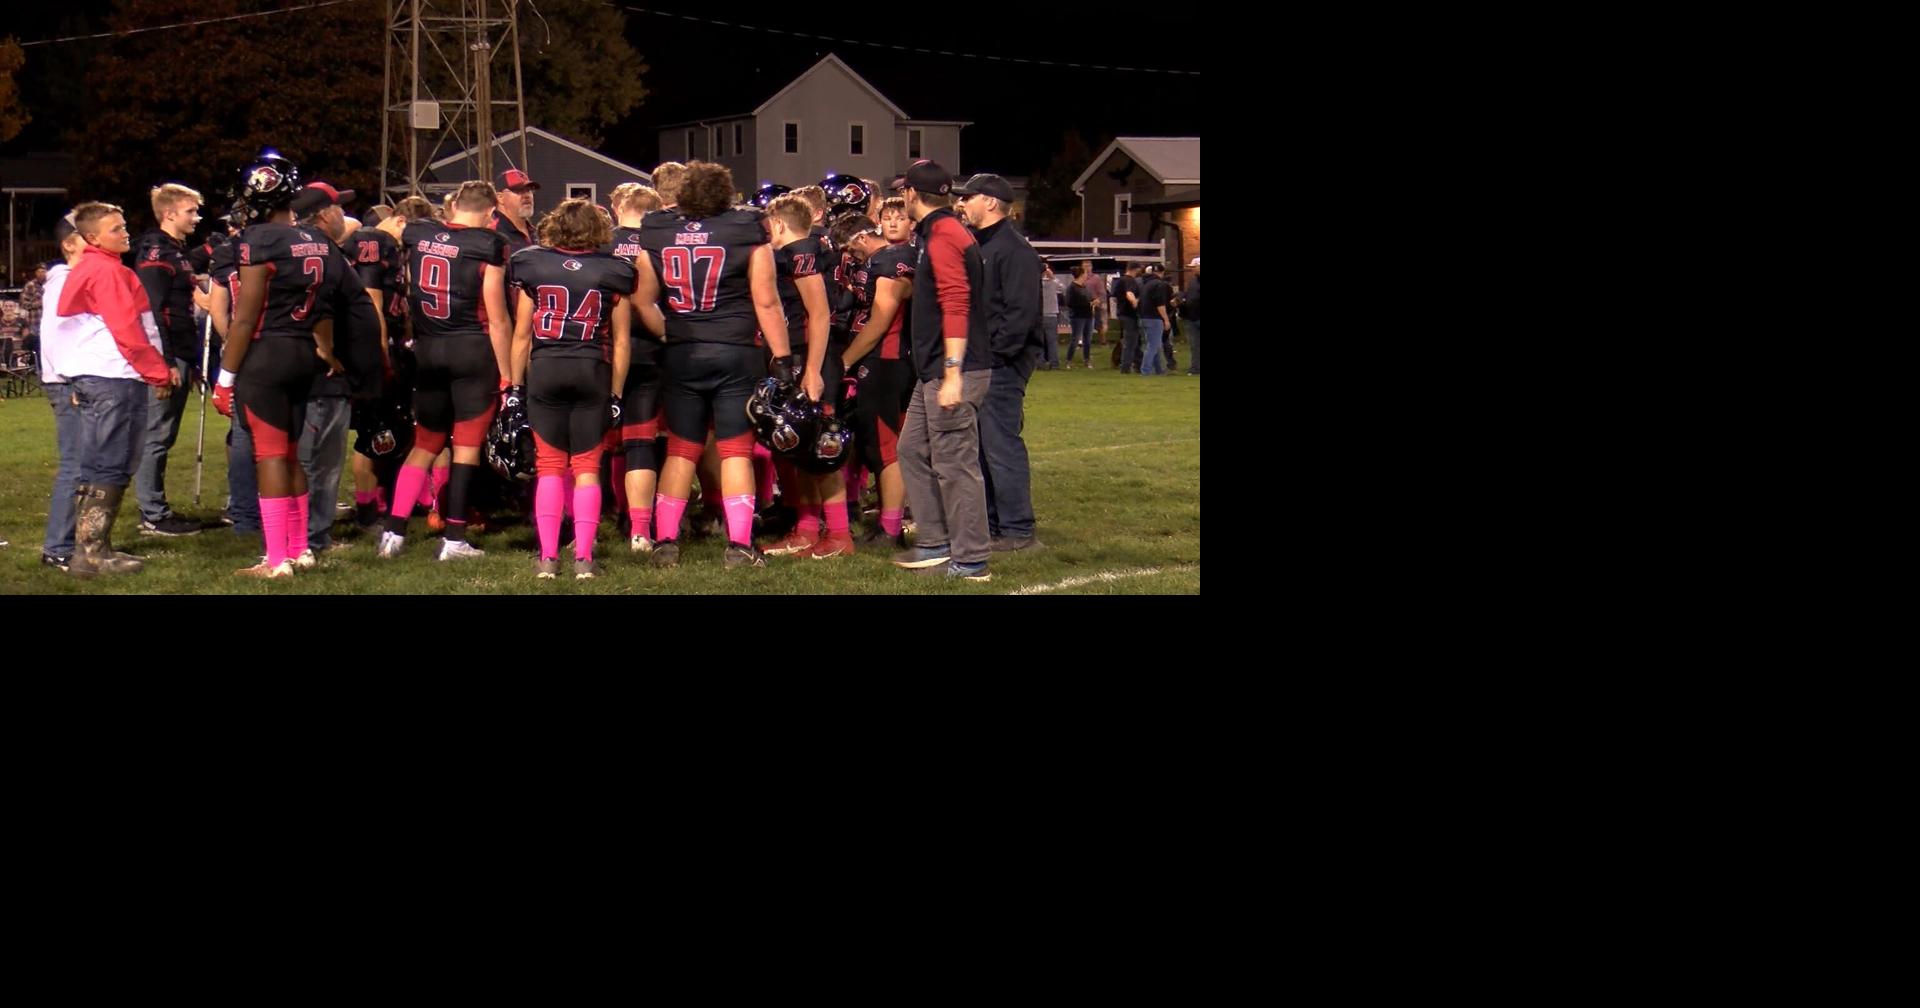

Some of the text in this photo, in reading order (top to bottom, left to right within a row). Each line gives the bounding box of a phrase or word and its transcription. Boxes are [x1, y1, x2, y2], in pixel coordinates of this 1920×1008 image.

[290, 256, 324, 321] 3
[418, 254, 450, 320] 9
[661, 246, 726, 313] 97
[793, 252, 817, 275] 22
[533, 285, 602, 341] 84
